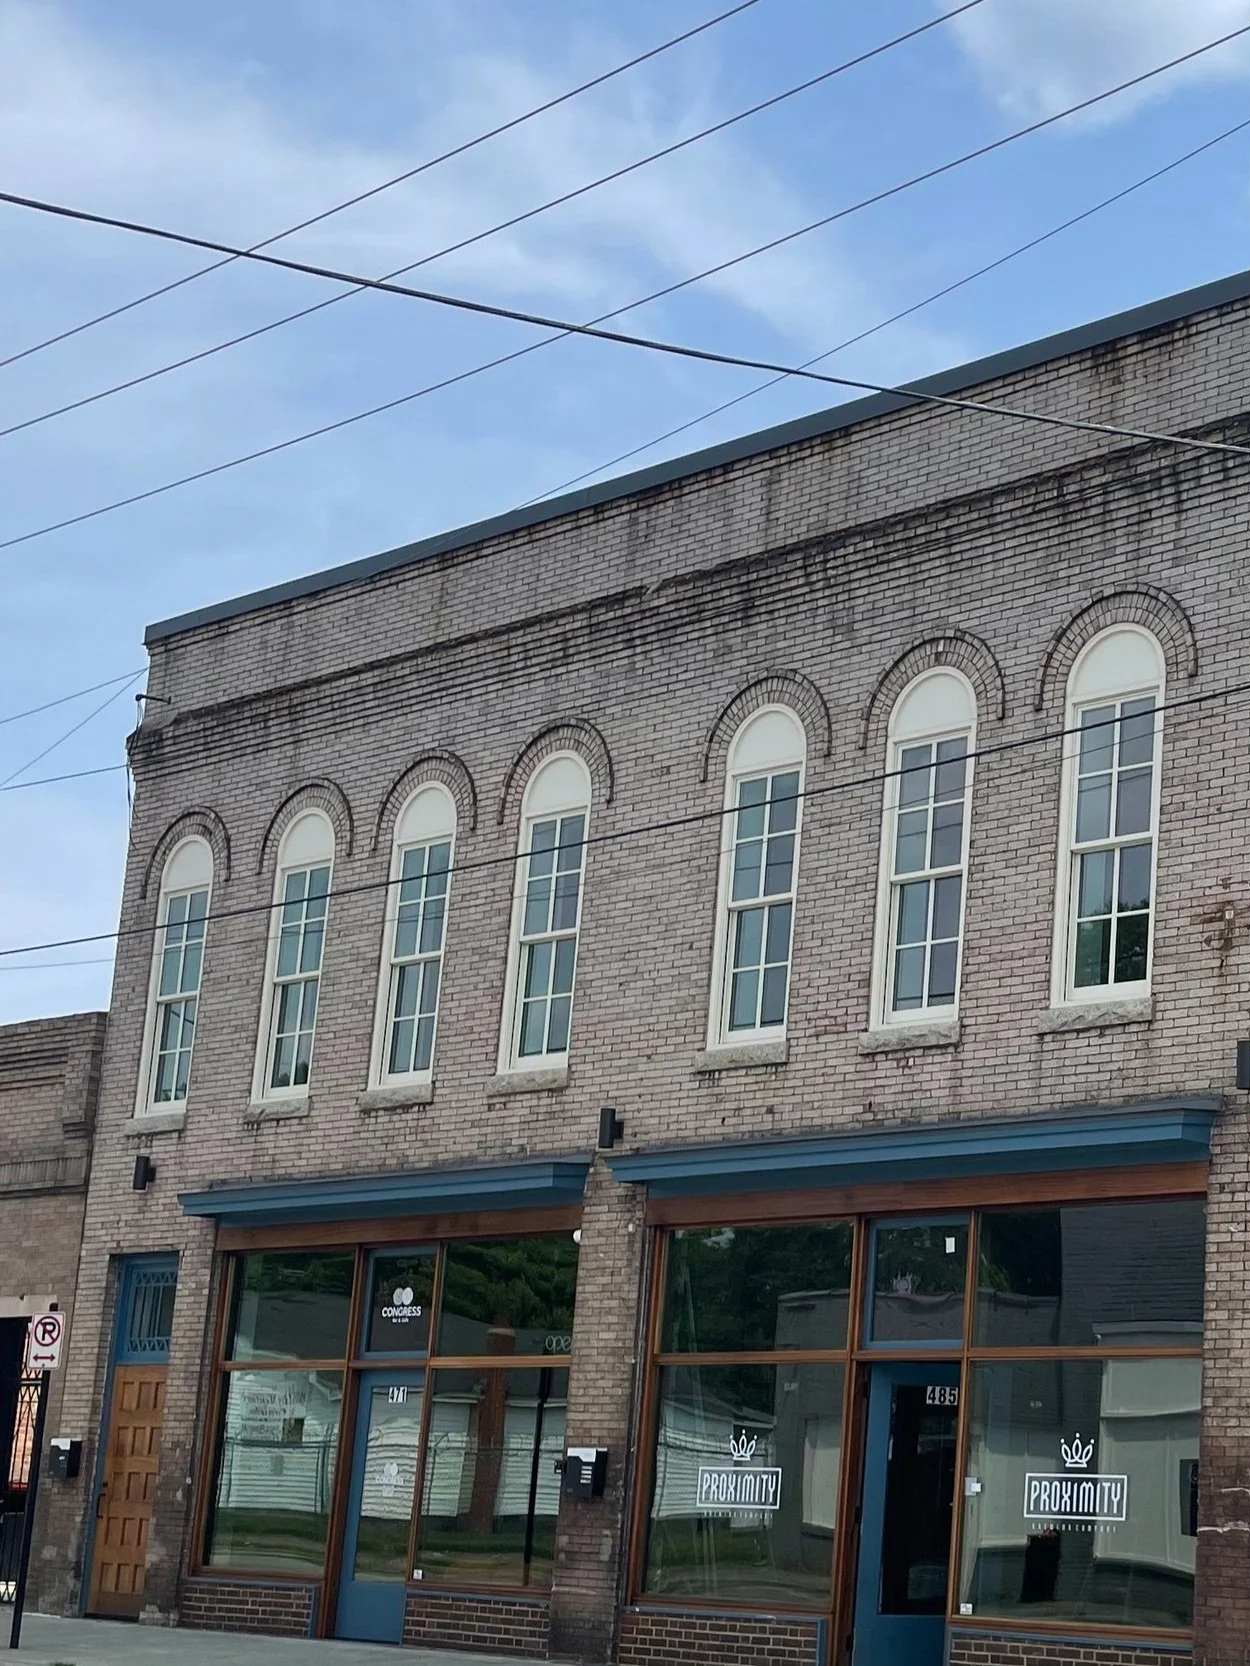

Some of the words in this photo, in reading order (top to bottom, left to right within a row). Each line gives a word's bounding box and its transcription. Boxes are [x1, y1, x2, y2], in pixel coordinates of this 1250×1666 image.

[381, 1306, 422, 1318] CONGRESS
[927, 1386, 958, 1404] 485
[702, 1472, 777, 1503] PROXIMITY
[1029, 1480, 1121, 1514] PROXIMITY
